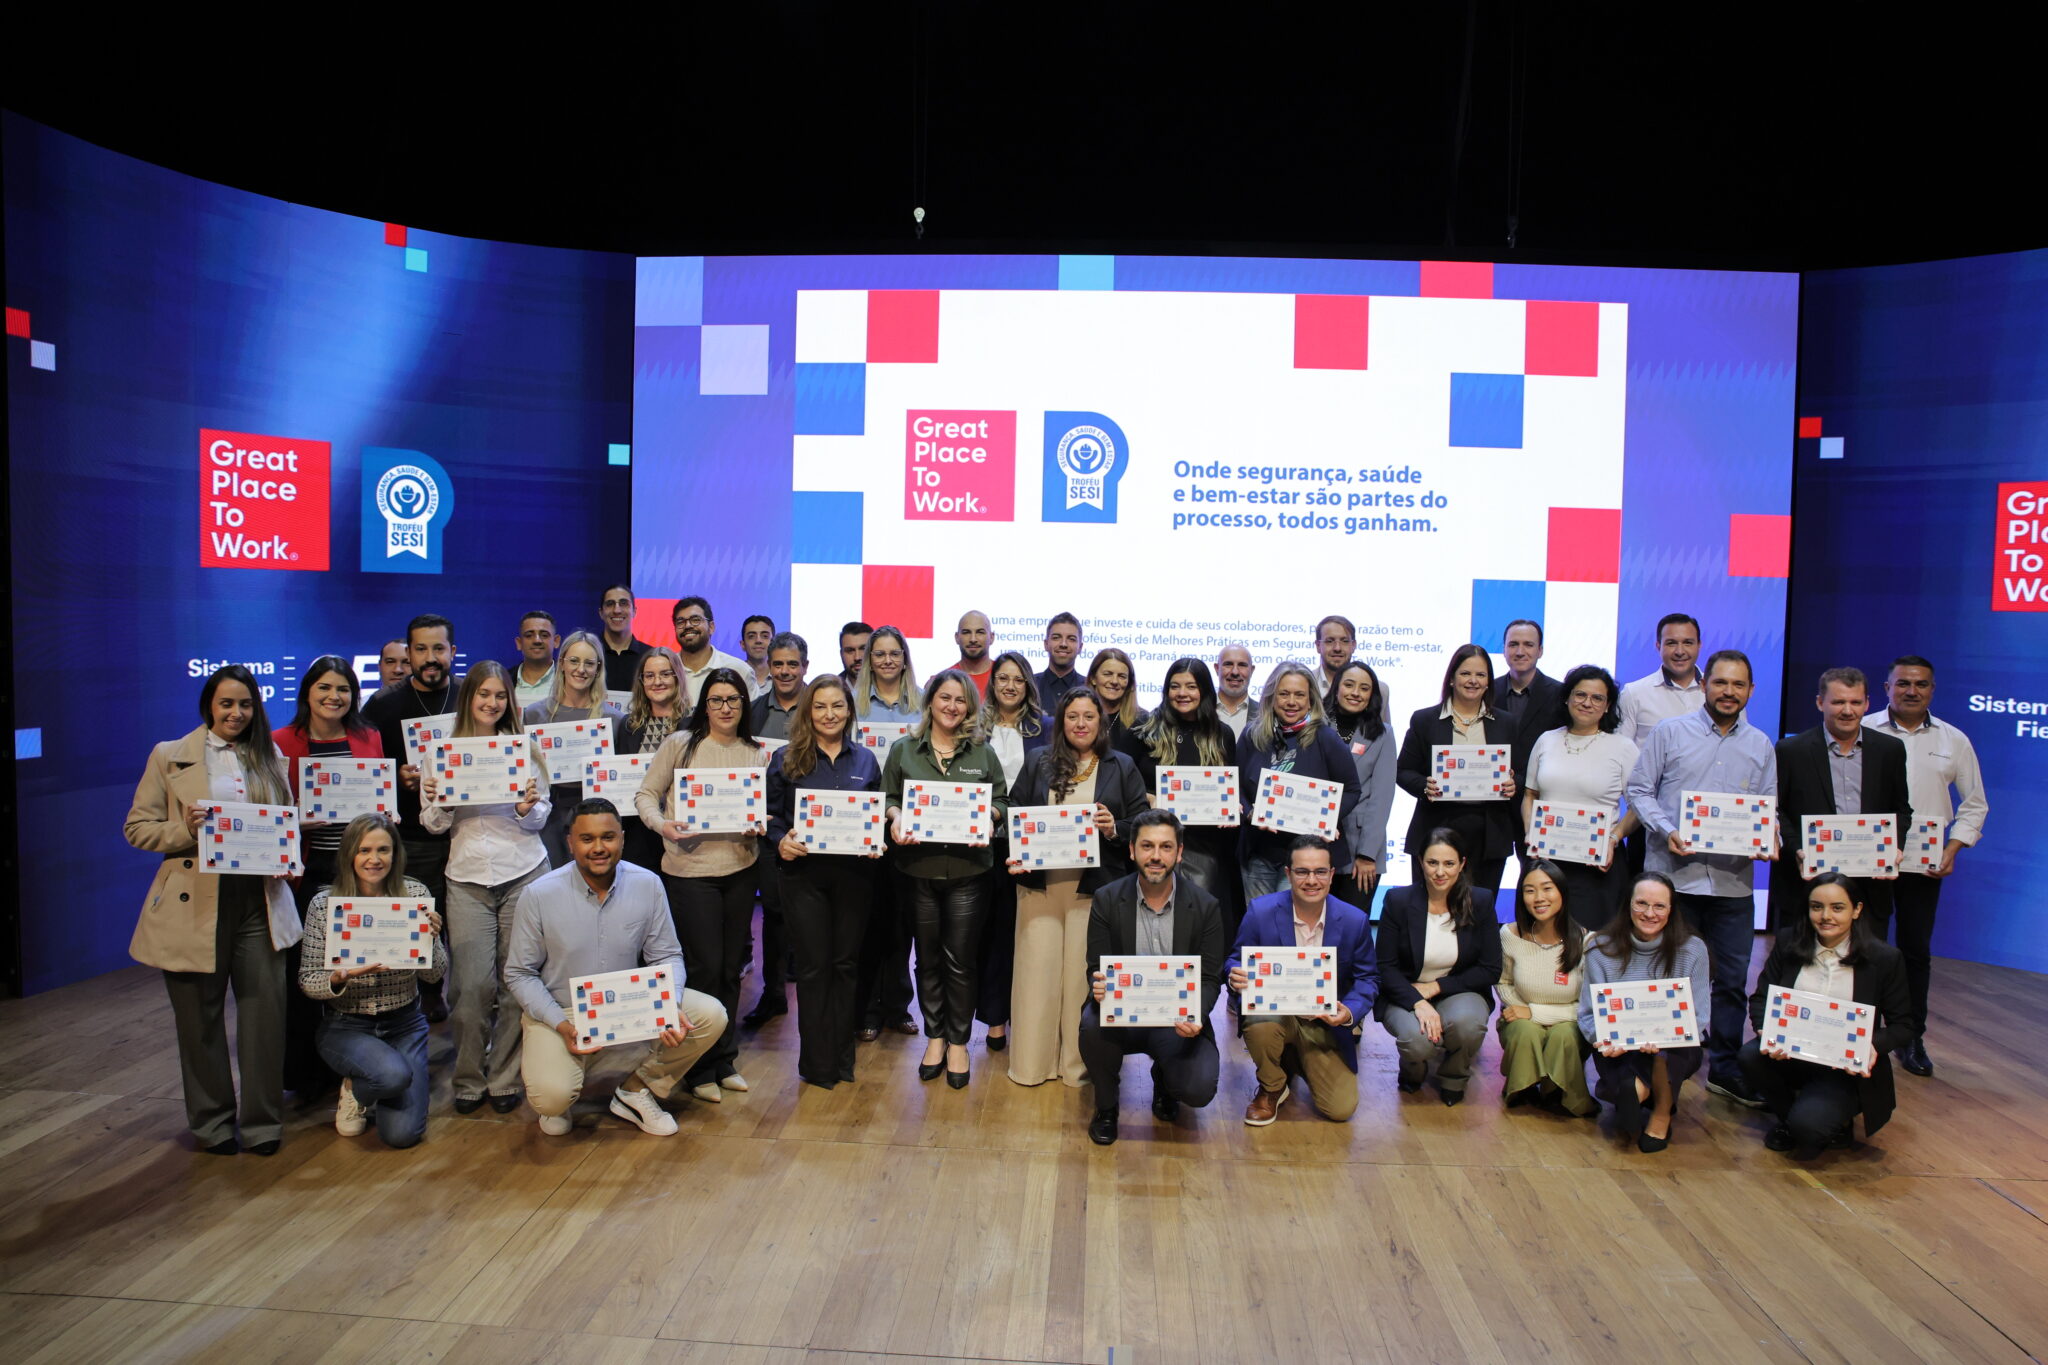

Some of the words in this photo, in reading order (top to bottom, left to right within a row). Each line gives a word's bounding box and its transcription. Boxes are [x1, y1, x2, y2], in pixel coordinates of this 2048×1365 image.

[913, 416, 988, 439] Great
[210, 439, 298, 473] Great
[915, 441, 987, 463] Place
[912, 466, 941, 487] To
[1071, 476, 1100, 486] TROFÉU
[1174, 460, 1231, 479] Onde
[1237, 465, 1353, 486] segurança,
[1358, 465, 1422, 484] saúde
[212, 469, 297, 501] Place
[1070, 486, 1100, 499] SESI
[1173, 488, 1185, 502] e
[1191, 484, 1300, 505] bem-estar
[1305, 487, 1342, 506] são
[1348, 491, 1415, 510] partes
[1420, 490, 1448, 509] do
[210, 501, 244, 527] To
[1173, 511, 1273, 531] processo,
[1278, 511, 1339, 530] todos
[1344, 513, 1438, 535] ganham.
[391, 522, 423, 532] TROFÉU
[391, 532, 423, 547] SESI
[2003, 549, 2044, 573] To
[992, 617, 1015, 625] uma
[1018, 617, 1050, 628] empr
[1094, 617, 1133, 628] investe
[1136, 620, 1143, 628] e
[1146, 618, 1176, 629] cuida
[1179, 619, 1193, 630] de
[1196, 621, 1221, 630] seus
[1223, 620, 1307, 633] colaboradores,
[1358, 624, 1389, 635] razão
[1391, 626, 1413, 636] tem
[1416, 627, 1424, 636] o
[1110, 633, 1132, 644] Sesi
[1135, 634, 1149, 645] de
[1152, 634, 1204, 646] Melhores
[1206, 635, 1249, 647] Práticas
[1252, 639, 1270, 648] em
[1374, 642, 1382, 651] e
[1384, 640, 1443, 653] Bem-estar,
[1139, 649, 1177, 661] Paraná
